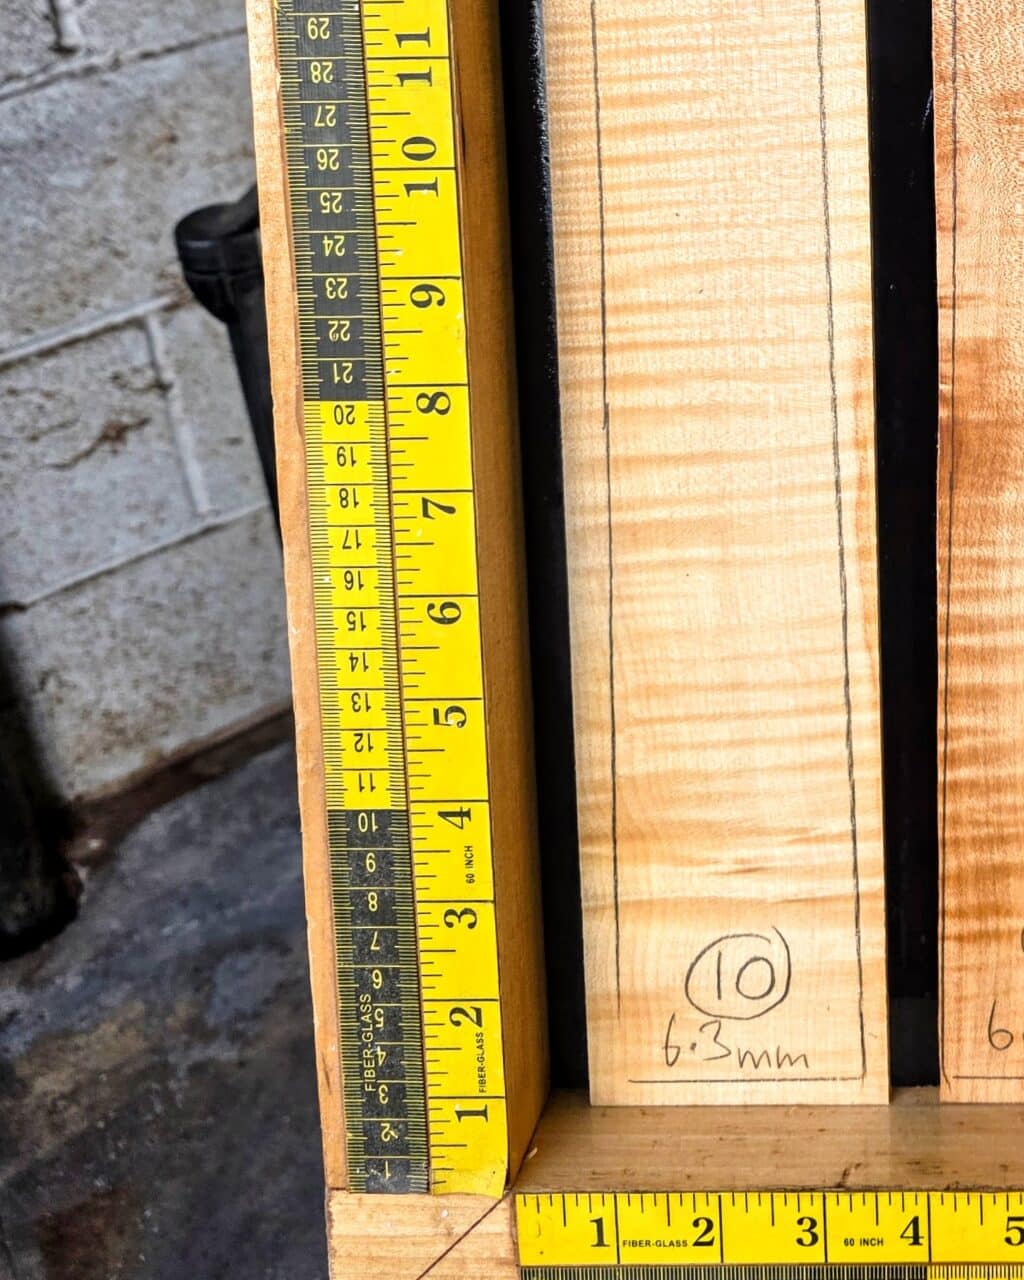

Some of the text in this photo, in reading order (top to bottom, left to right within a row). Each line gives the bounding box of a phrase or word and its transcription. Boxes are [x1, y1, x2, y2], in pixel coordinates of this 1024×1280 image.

[307, 17, 330, 40] 29
[395, 27, 433, 87] 11
[310, 62, 333, 83] 28
[314, 105, 336, 127] 27
[316, 149, 339, 170] 26
[401, 136, 439, 198] 10
[320, 192, 342, 214] 25
[323, 235, 345, 257] 24
[325, 278, 348, 299] 23
[410, 283, 446, 308] 9
[328, 320, 350, 341] 22
[332, 363, 353, 384] 21
[416, 391, 450, 415] 8
[334, 405, 355, 425] 20
[336, 446, 357, 467] 19
[339, 488, 360, 508] 18
[422, 497, 456, 520] 7
[342, 529, 362, 549] 17
[344, 570, 364, 591] 16
[347, 611, 367, 632] 15
[427, 601, 461, 625] 6
[350, 652, 369, 672] 14
[351, 692, 372, 713] 13
[433, 705, 467, 729] 5
[354, 733, 374, 753] 12
[358, 773, 376, 792] 11
[358, 813, 378, 833] 10
[437, 806, 472, 830] 4
[366, 853, 376, 872] 9
[464, 845, 475, 884] 60 INCH
[368, 892, 377, 912] 8
[444, 907, 478, 930] 3
[370, 931, 381, 950] 7
[372, 970, 383, 989] 6
[717, 949, 775, 1001] 10
[374, 1009, 384, 1030] 5
[449, 1006, 483, 1028] 2
[360, 993, 376, 1092] FIBER-GLASS
[375, 1046, 387, 1066] 4
[476, 1031, 487, 1094] FIBER-GLASS
[377, 1085, 389, 1104] 3
[455, 1104, 489, 1124] 1
[381, 1123, 396, 1142] 2
[382, 1161, 391, 1179] 1
[590, 1217, 610, 1248] 1
[692, 1216, 716, 1247] 2
[796, 1216, 819, 1247] 3
[900, 1216, 925, 1247] 4
[843, 1237, 884, 1247] 60 INCH
[622, 1239, 688, 1248] FIBER-GLASS
